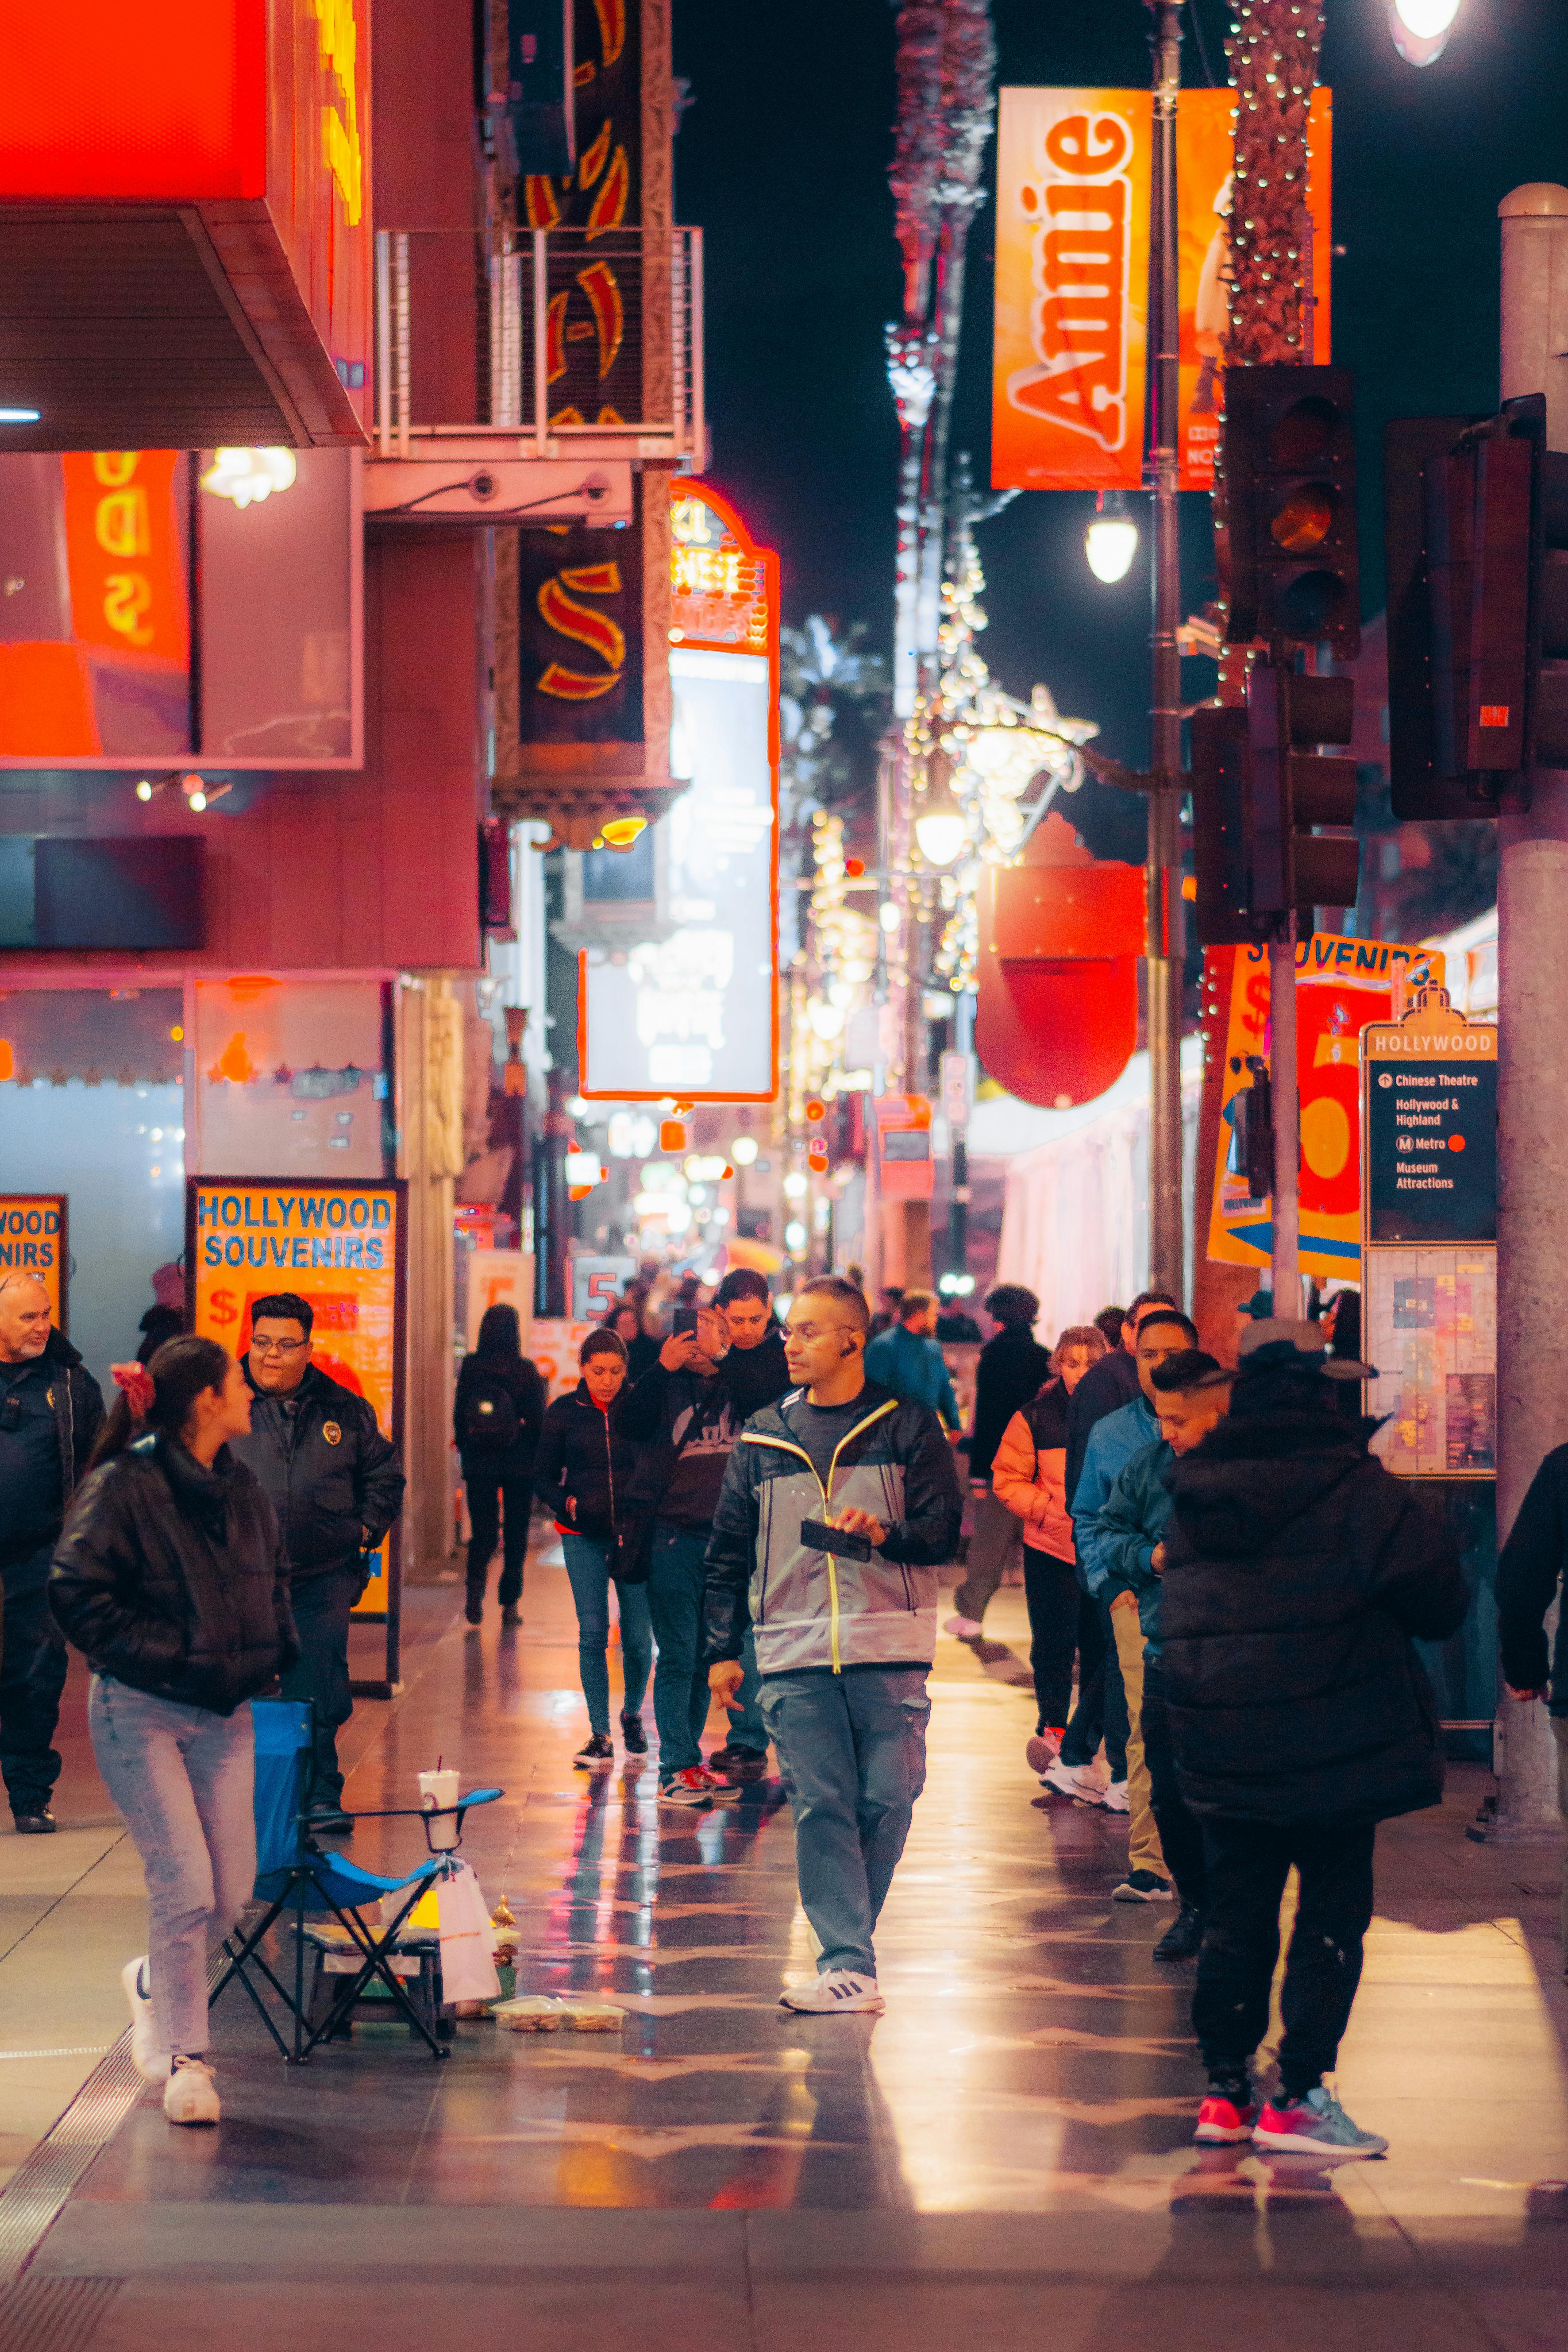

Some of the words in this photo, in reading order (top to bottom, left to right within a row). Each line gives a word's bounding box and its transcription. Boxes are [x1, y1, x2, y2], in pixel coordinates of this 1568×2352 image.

[1009, 112, 1131, 450] Annie
[1375, 1035, 1491, 1052] HOLLYWOOD
[1395, 1074, 1436, 1086] Chinese
[1438, 1074, 1479, 1086] Theatre
[1396, 1098, 1449, 1112] Hollywood
[1451, 1098, 1459, 1110] &
[1396, 1114, 1441, 1128] Highland
[1416, 1137, 1446, 1150] Metro
[1396, 1162, 1439, 1174] Museum
[1396, 1177, 1454, 1189] Attractions
[198, 1196, 391, 1230] HOLLYWOOD
[204, 1235, 384, 1269] SOUVENIRS
